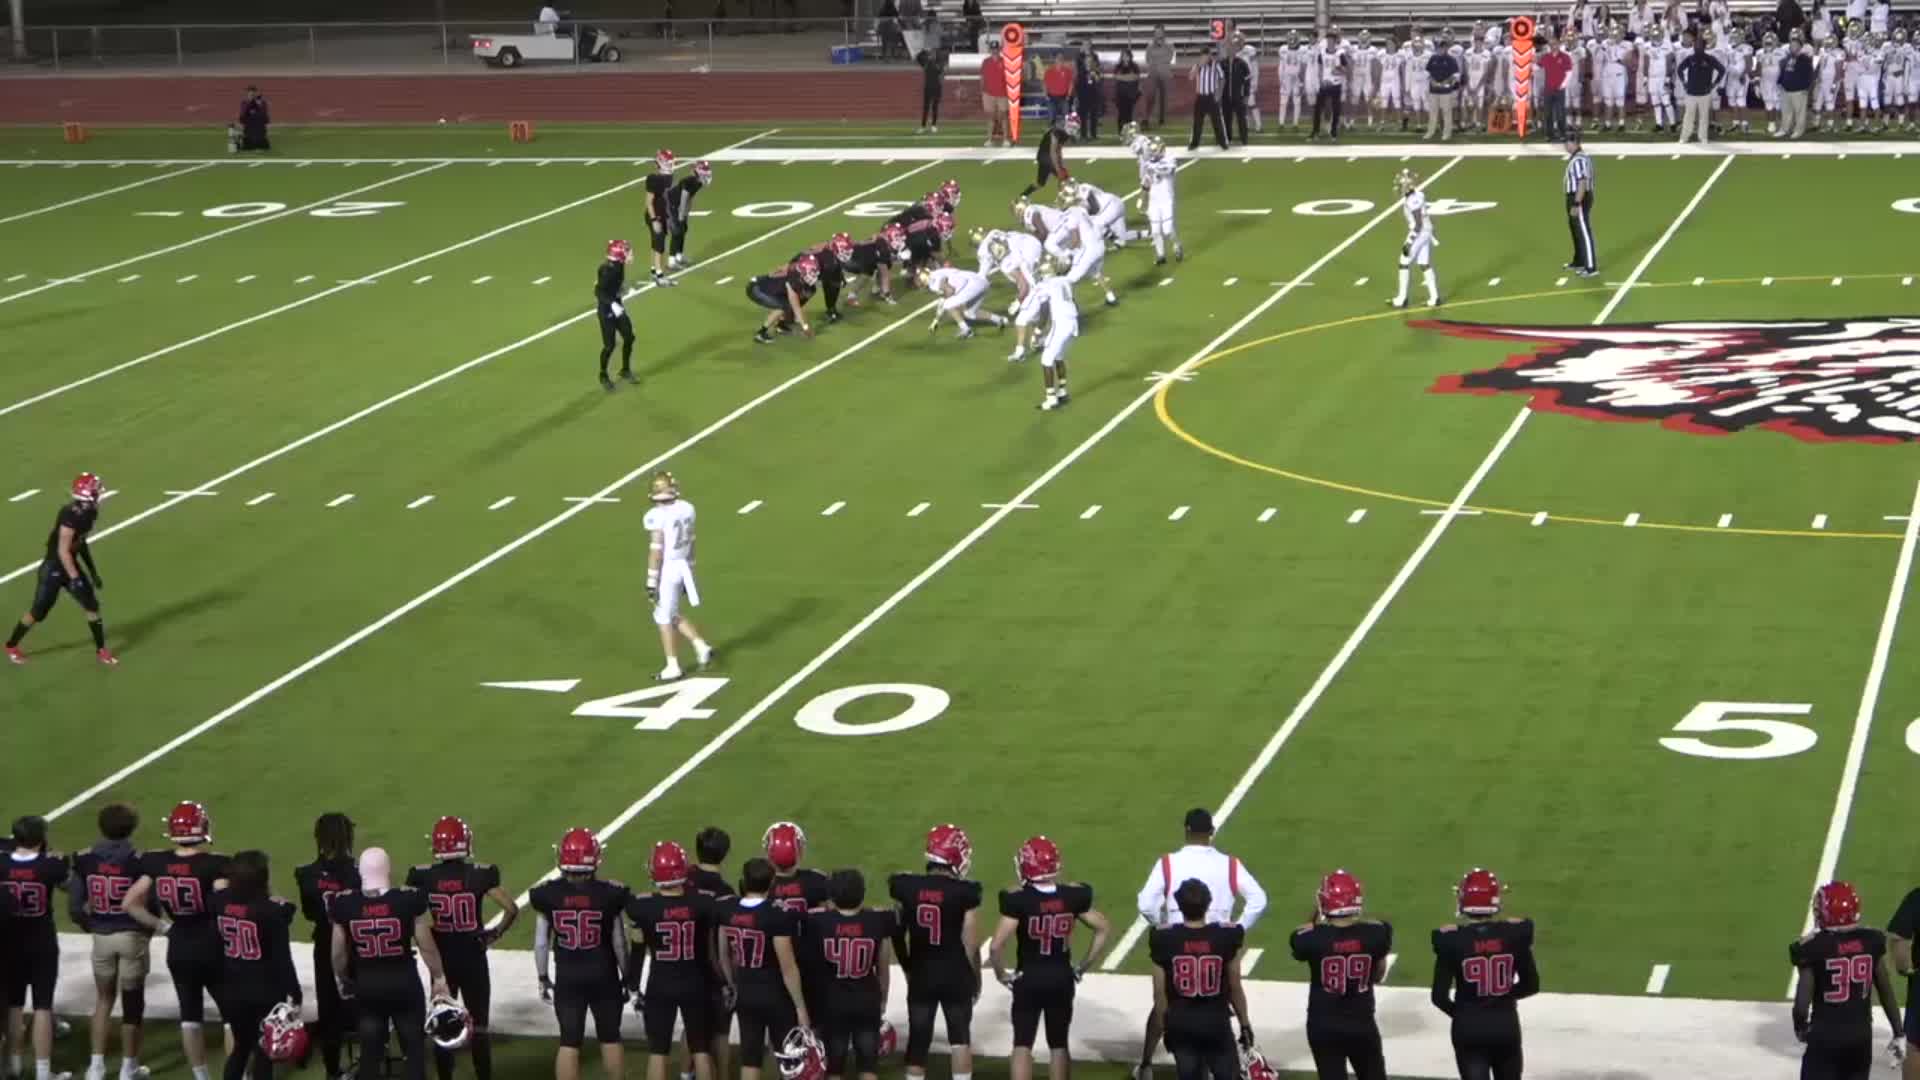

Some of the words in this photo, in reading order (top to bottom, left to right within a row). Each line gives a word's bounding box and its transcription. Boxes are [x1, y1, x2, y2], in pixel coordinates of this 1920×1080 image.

[87, 875, 132, 915] 85
[155, 876, 205, 915] 93
[429, 892, 477, 933] 20
[217, 915, 262, 961] 50
[349, 917, 404, 959] 52
[552, 909, 603, 951] 56
[655, 920, 696, 962] 31
[916, 903, 943, 946] 9
[1027, 913, 1076, 956] 49
[823, 936, 877, 980] 40
[1172, 954, 1224, 998] 80
[1320, 953, 1373, 996] 89
[1461, 953, 1515, 998] 90
[1824, 953, 1874, 1003] 39
